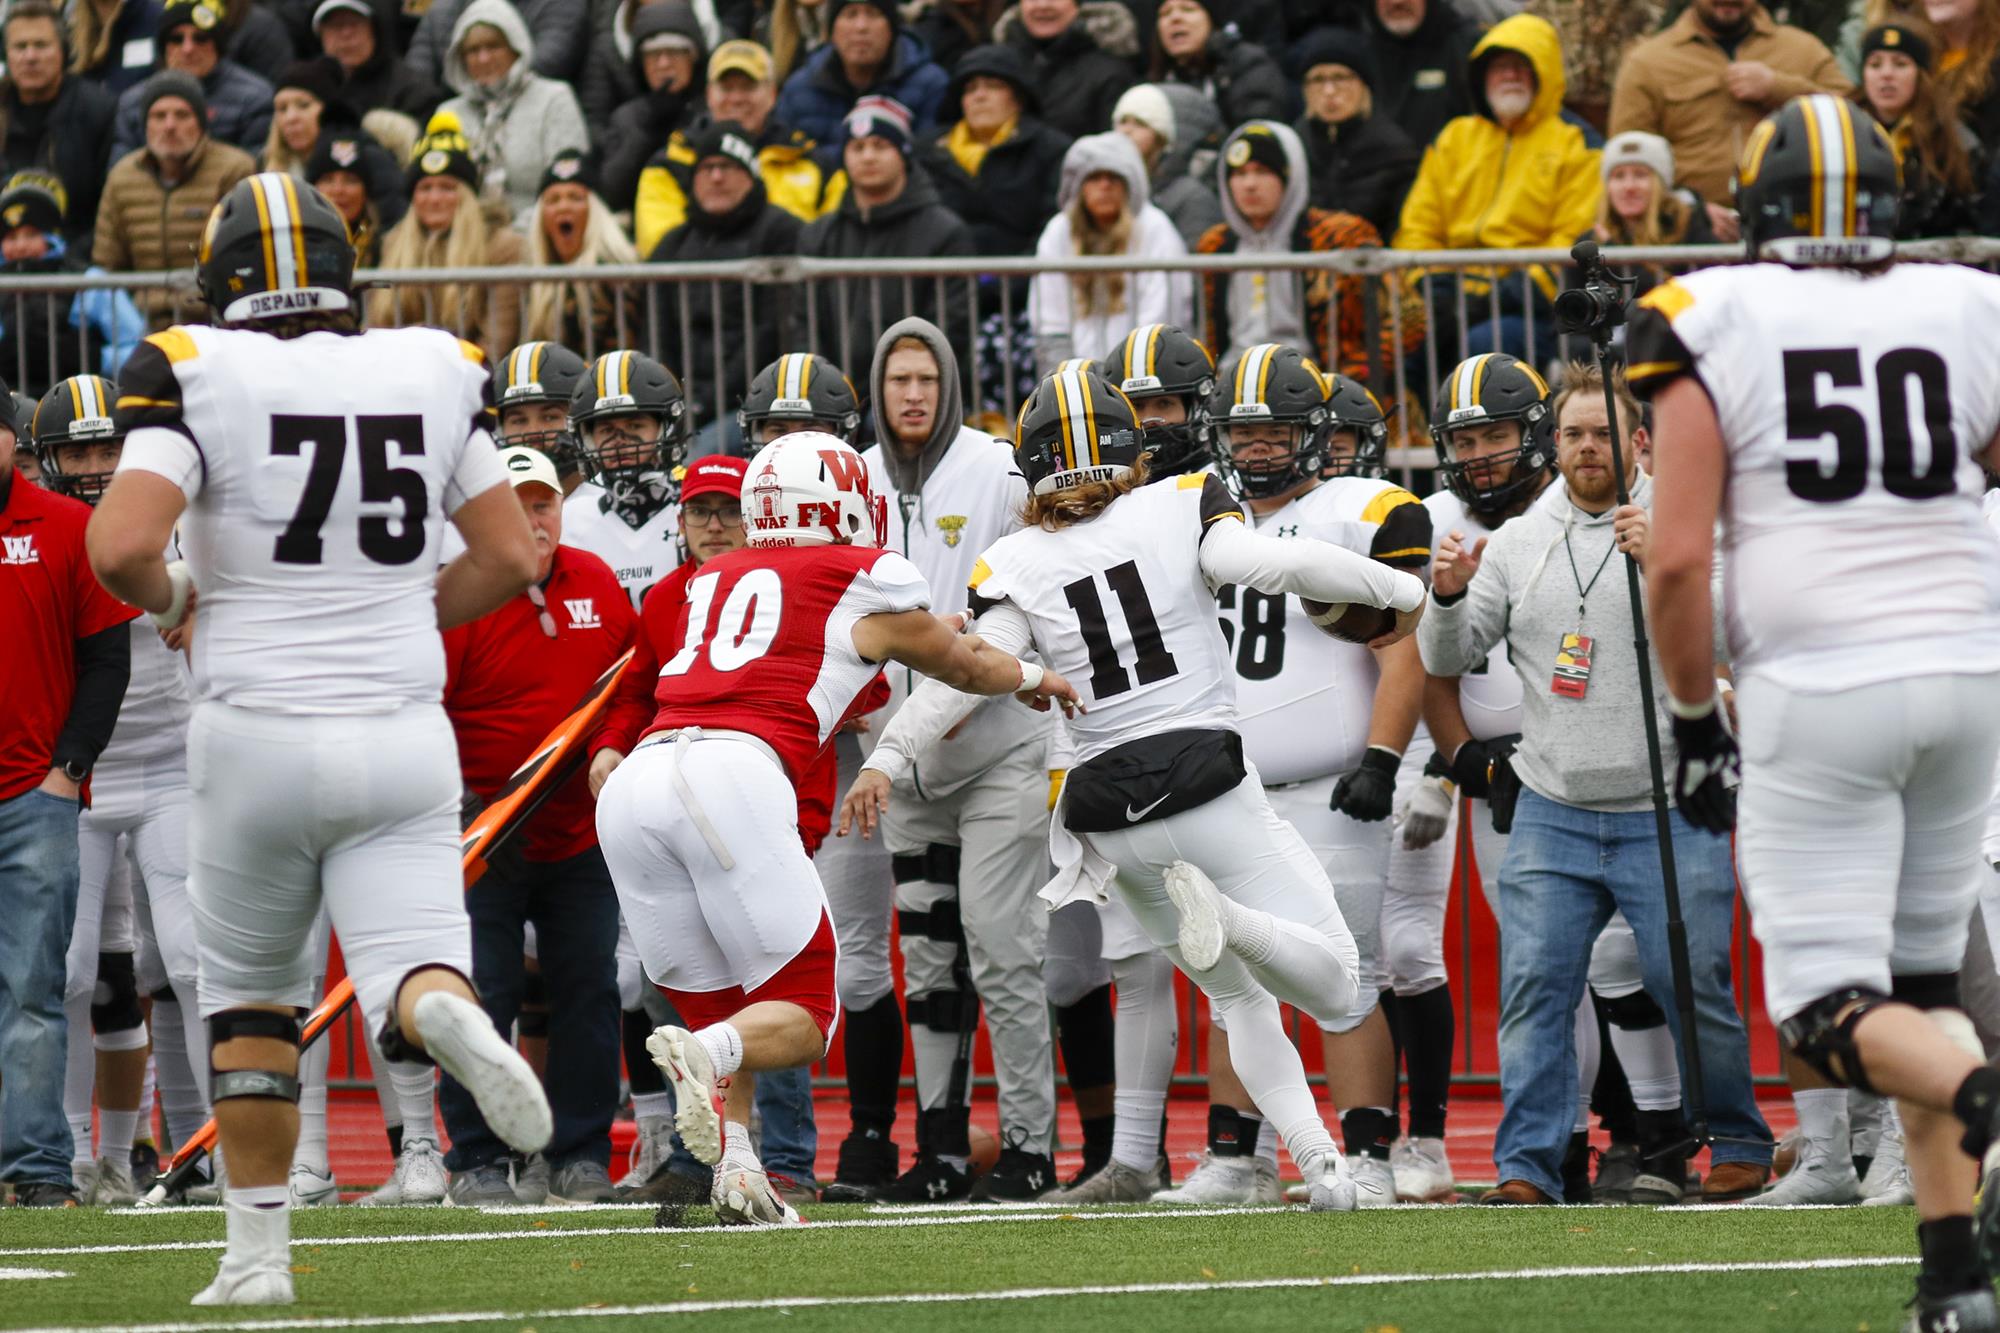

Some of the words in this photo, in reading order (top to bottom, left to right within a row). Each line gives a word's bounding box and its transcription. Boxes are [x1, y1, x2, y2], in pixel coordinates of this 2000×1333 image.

[250, 292, 320, 314] DEPAUW
[1782, 347, 1958, 503] 50
[270, 414, 428, 566] 75
[817, 450, 869, 506] W
[1054, 468, 1114, 489] DEPAUW
[754, 516, 789, 530] WAF
[659, 568, 783, 677] 10
[1063, 560, 1179, 700] 11
